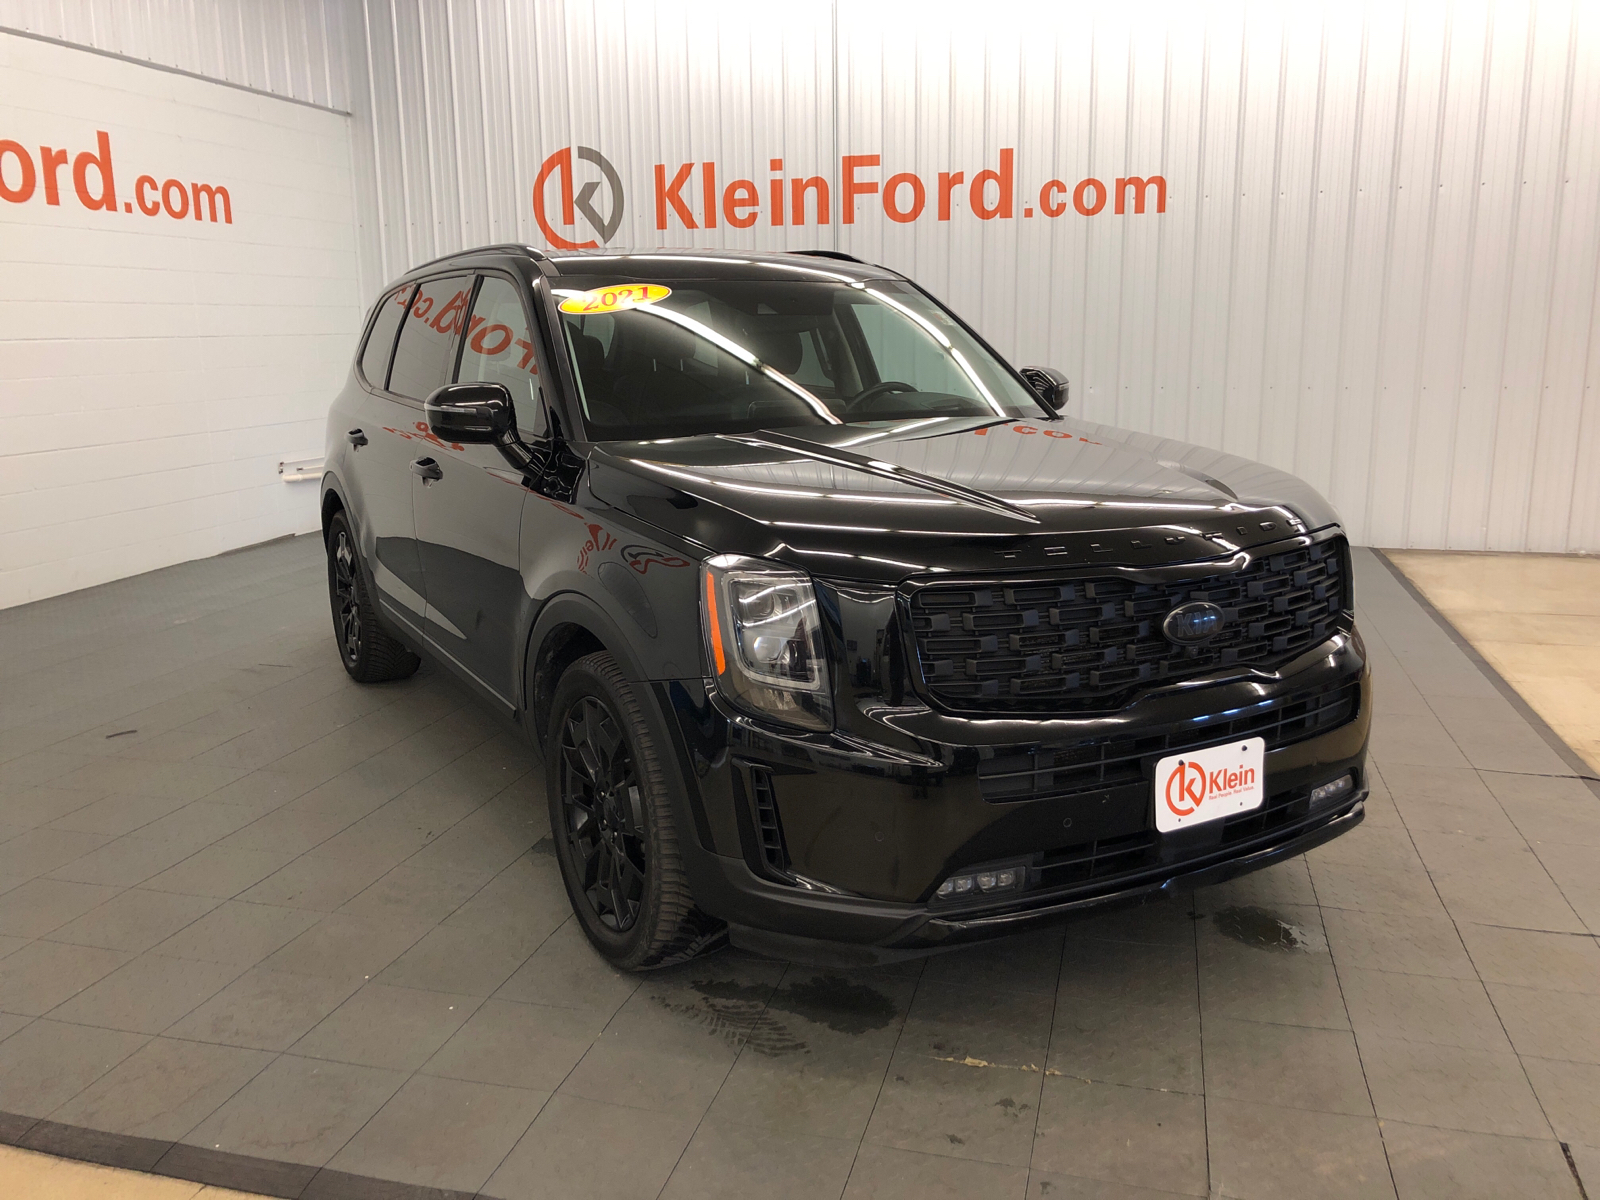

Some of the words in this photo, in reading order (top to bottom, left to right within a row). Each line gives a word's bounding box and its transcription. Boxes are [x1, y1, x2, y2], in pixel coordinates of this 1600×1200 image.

[654, 148, 1167, 231] KleinFord.com
[582, 286, 651, 312] 2021
[1176, 609, 1218, 637] KIA
[1209, 764, 1255, 794] Klein
